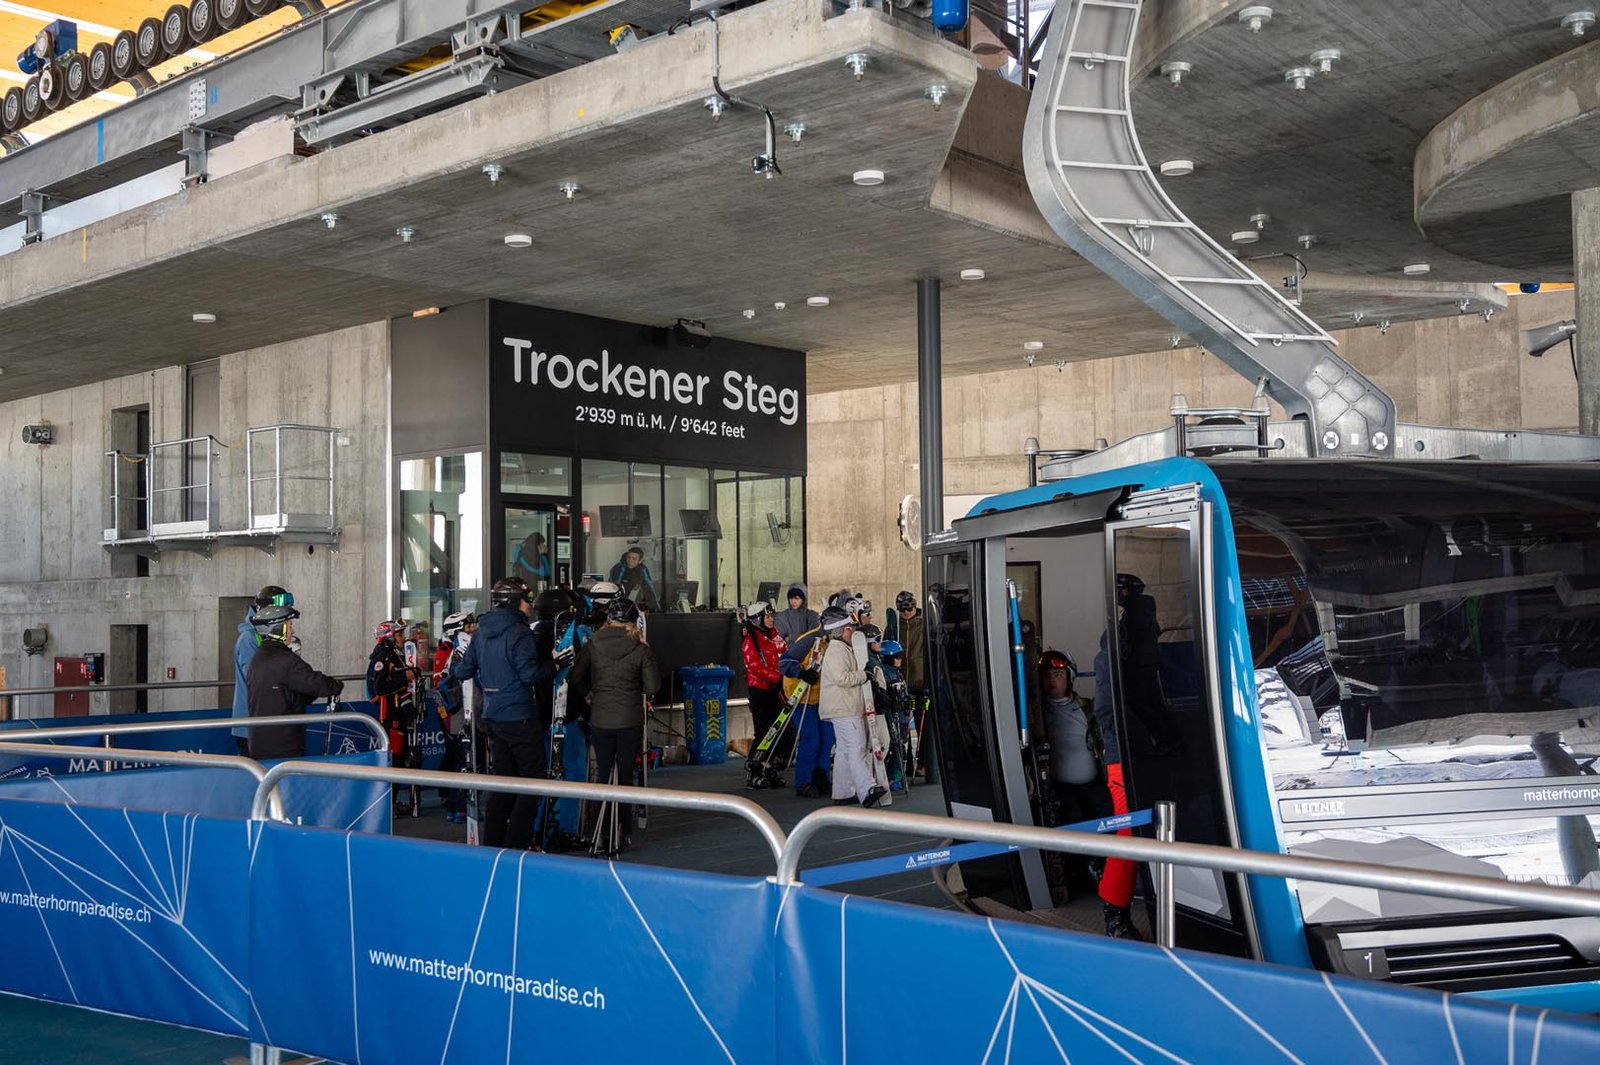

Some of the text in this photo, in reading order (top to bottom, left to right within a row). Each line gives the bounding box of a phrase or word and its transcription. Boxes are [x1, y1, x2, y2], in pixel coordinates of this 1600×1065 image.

[503, 337, 798, 426] Trockener Steg
[720, 421, 746, 439] feet
[1294, 800, 1345, 814] LEITNER
[1363, 952, 1374, 974] 1
[369, 949, 606, 1010] www.matterhornparadise.ch
